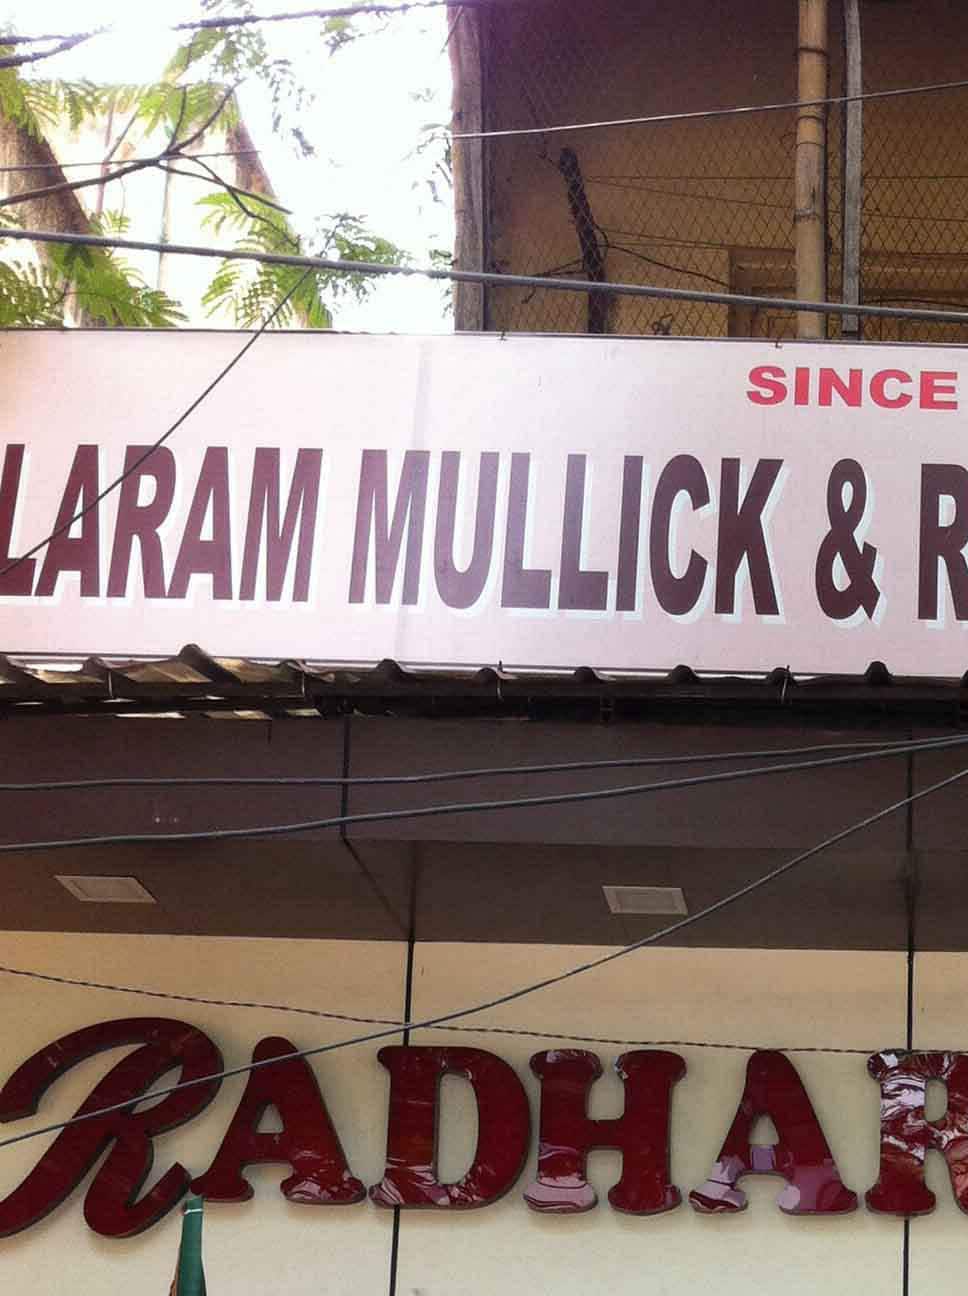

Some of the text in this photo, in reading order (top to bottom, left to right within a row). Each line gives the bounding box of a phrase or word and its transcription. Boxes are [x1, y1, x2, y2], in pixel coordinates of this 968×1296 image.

[746, 366, 958, 410] SINCE
[348, 448, 784, 616] MULLICK
[815, 458, 880, 622] &
